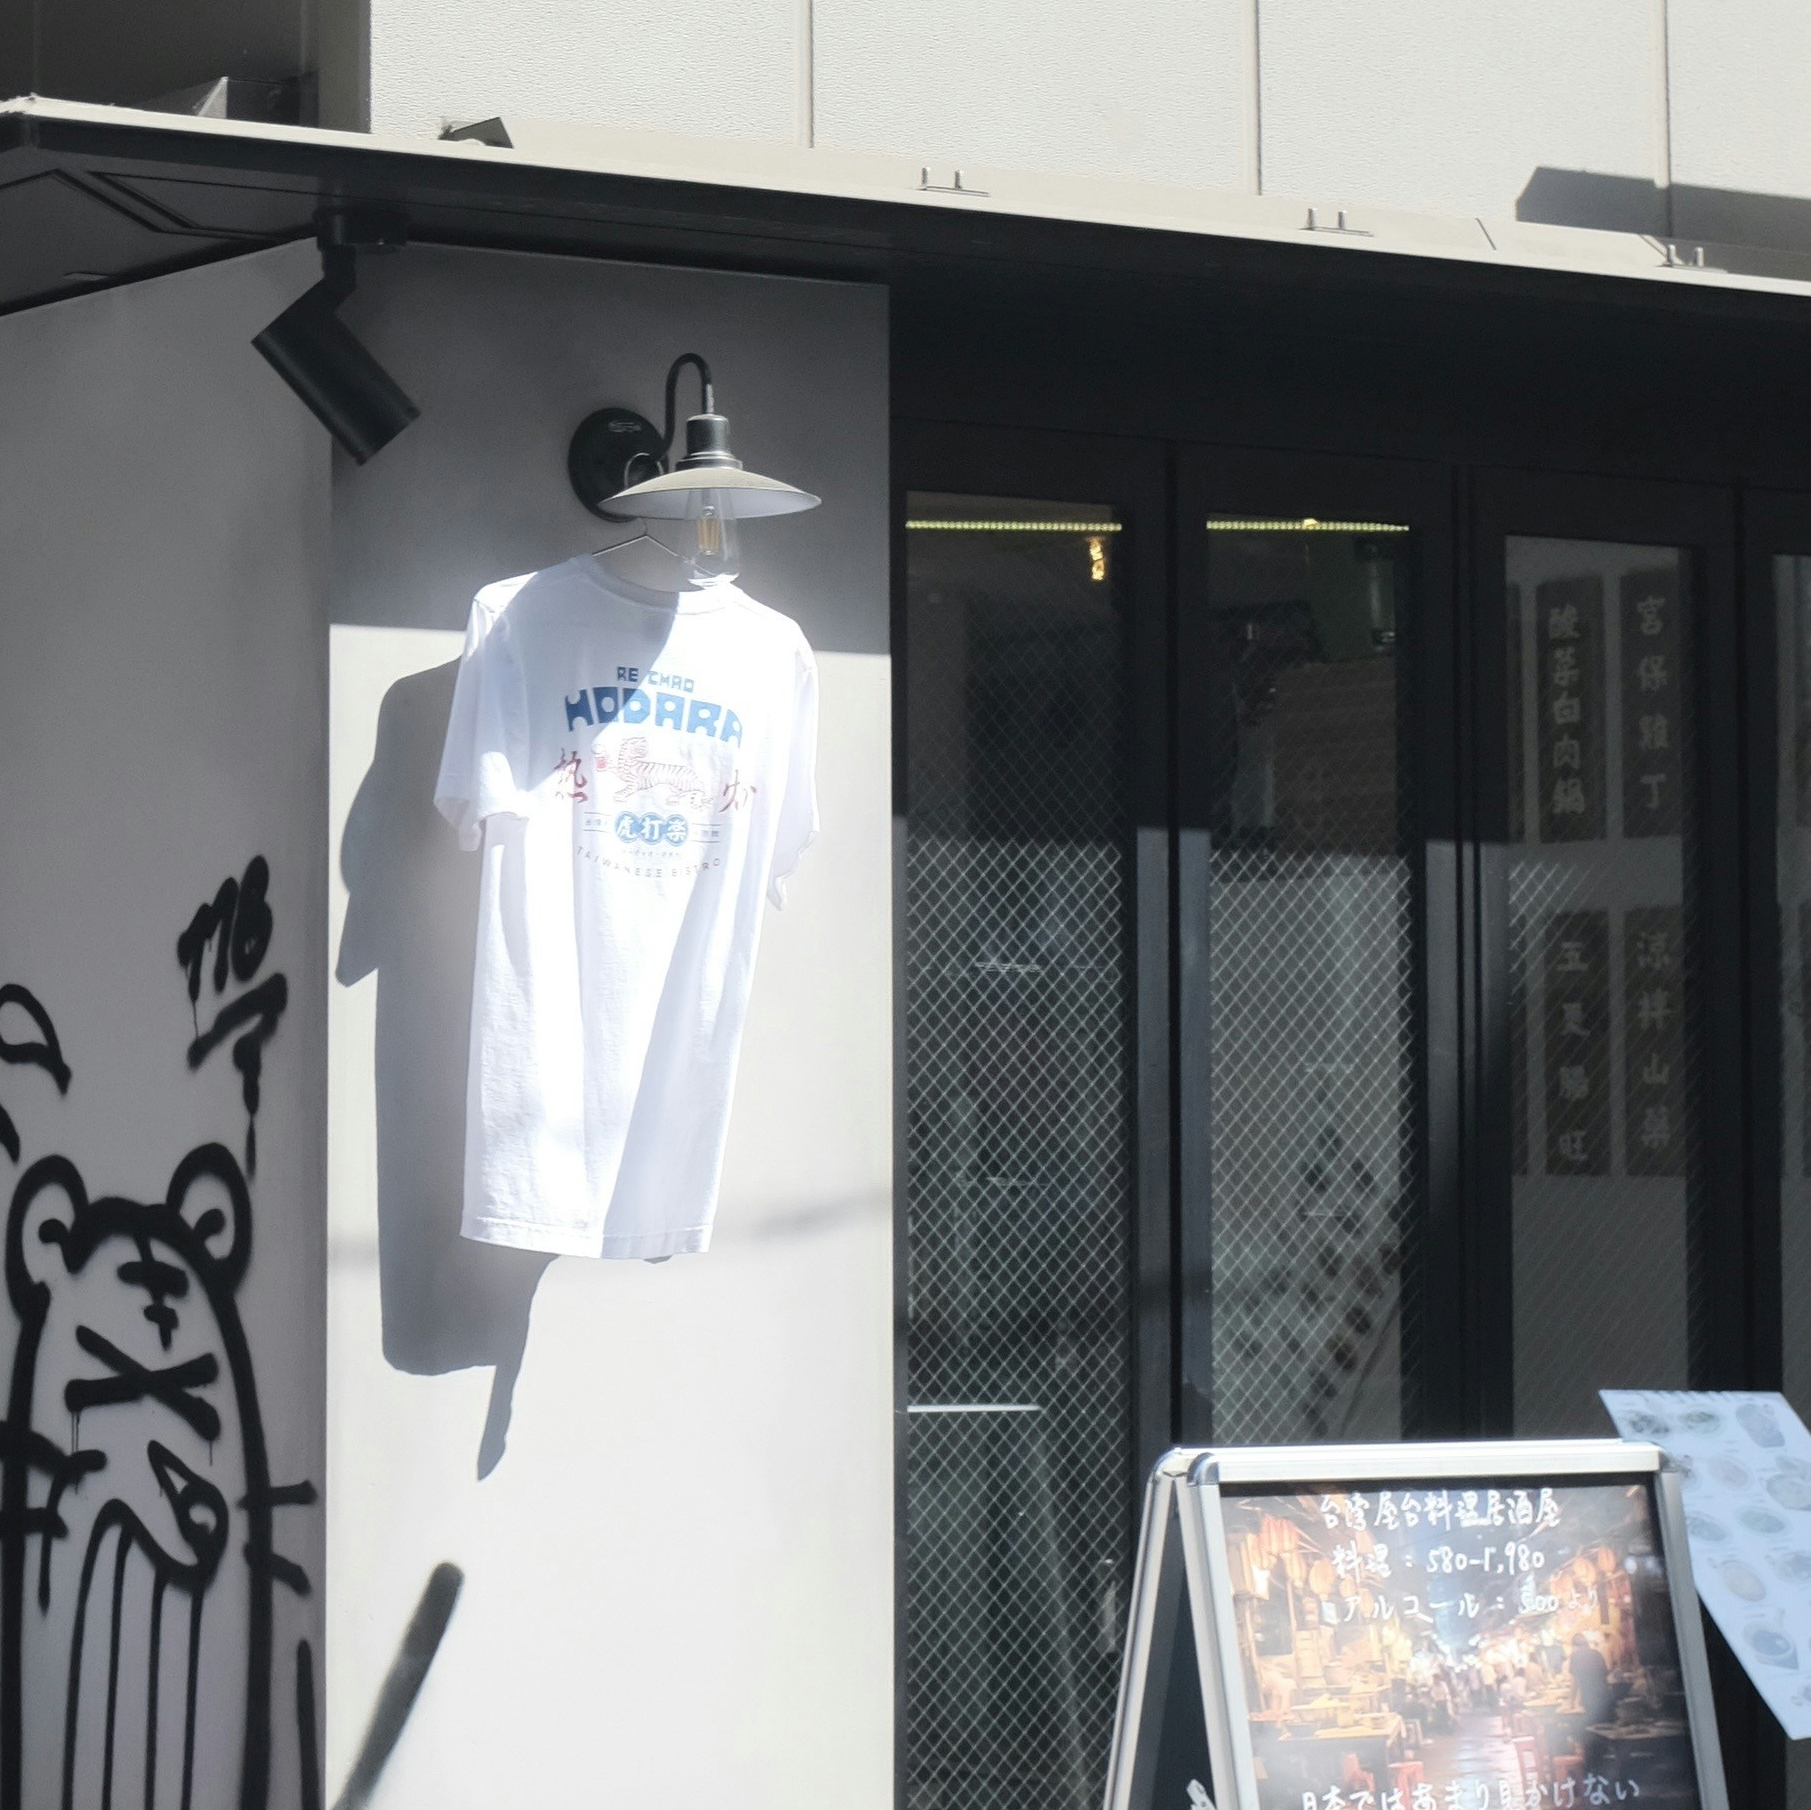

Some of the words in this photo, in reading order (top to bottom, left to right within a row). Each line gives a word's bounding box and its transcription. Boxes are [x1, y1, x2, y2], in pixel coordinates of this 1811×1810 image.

[617, 666, 639, 683] RE
[647, 670, 695, 693] CHAO
[565, 687, 743, 748] HODARA
[576, 846, 663, 878] TAIWANESE
